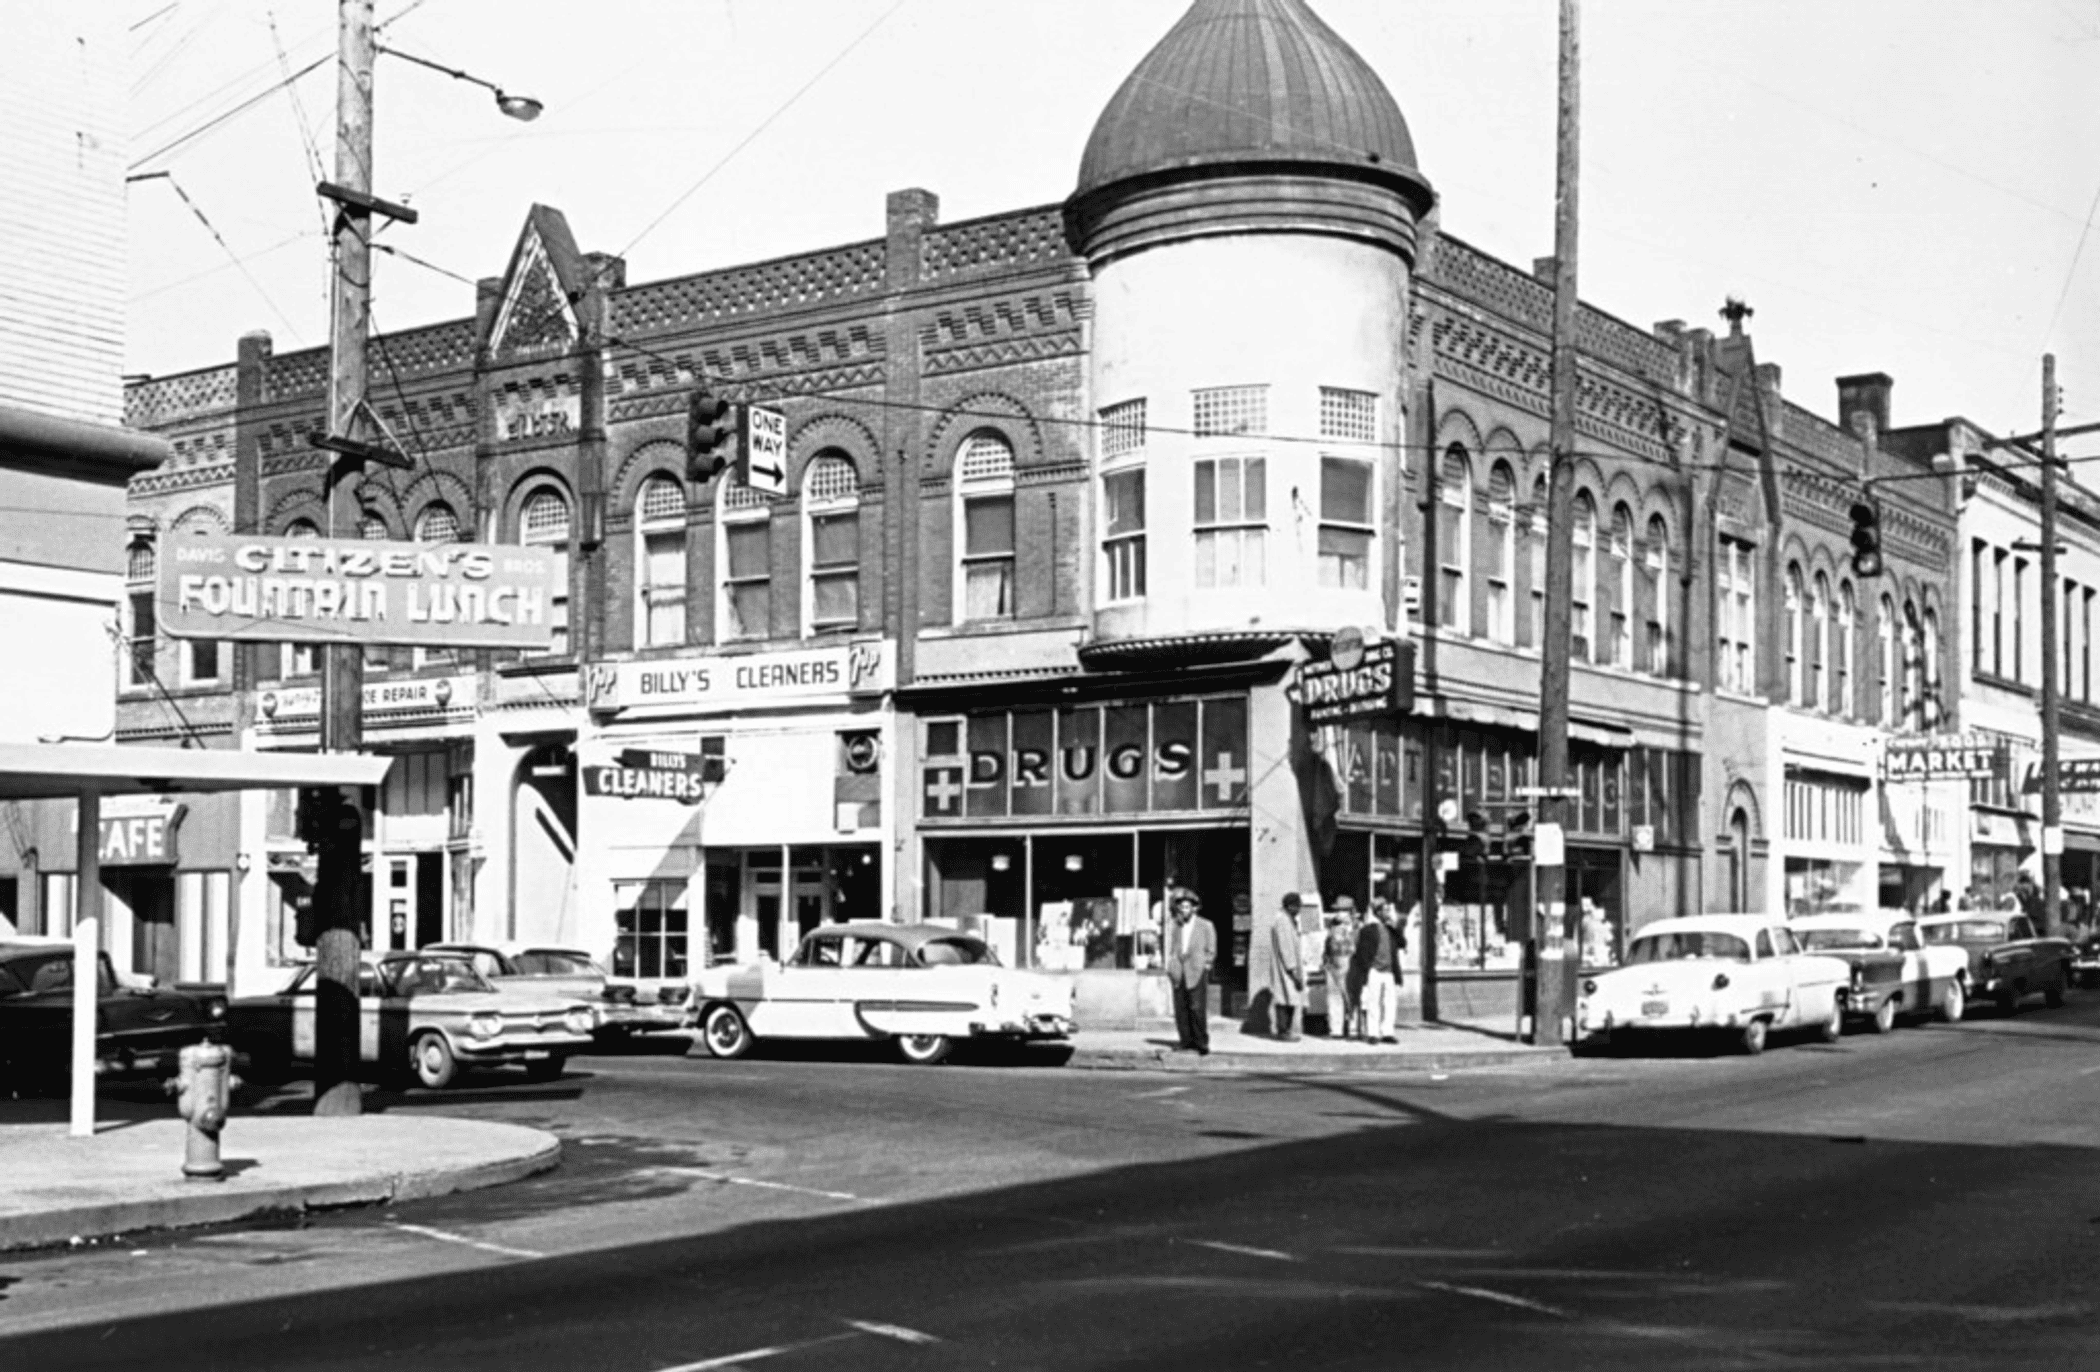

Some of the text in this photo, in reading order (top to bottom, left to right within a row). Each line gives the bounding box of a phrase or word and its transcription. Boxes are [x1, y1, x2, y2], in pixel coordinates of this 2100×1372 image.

[752, 409, 783, 436] ONE
[752, 433, 783, 456] WAY
[176, 548, 226, 564] DAVIS
[235, 544, 494, 581] CITIZEN'S
[180, 574, 543, 625] FOUNTAIN LUNCH
[640, 659, 840, 694] BILLY'S CLEANERS
[1303, 662, 1393, 705] DRUGS
[382, 684, 428, 702] REPAIR
[966, 739, 1193, 789] DRUGS
[1886, 749, 1995, 774] MARKET
[598, 768, 702, 798] CLEANERS
[99, 819, 164, 859] AFE
